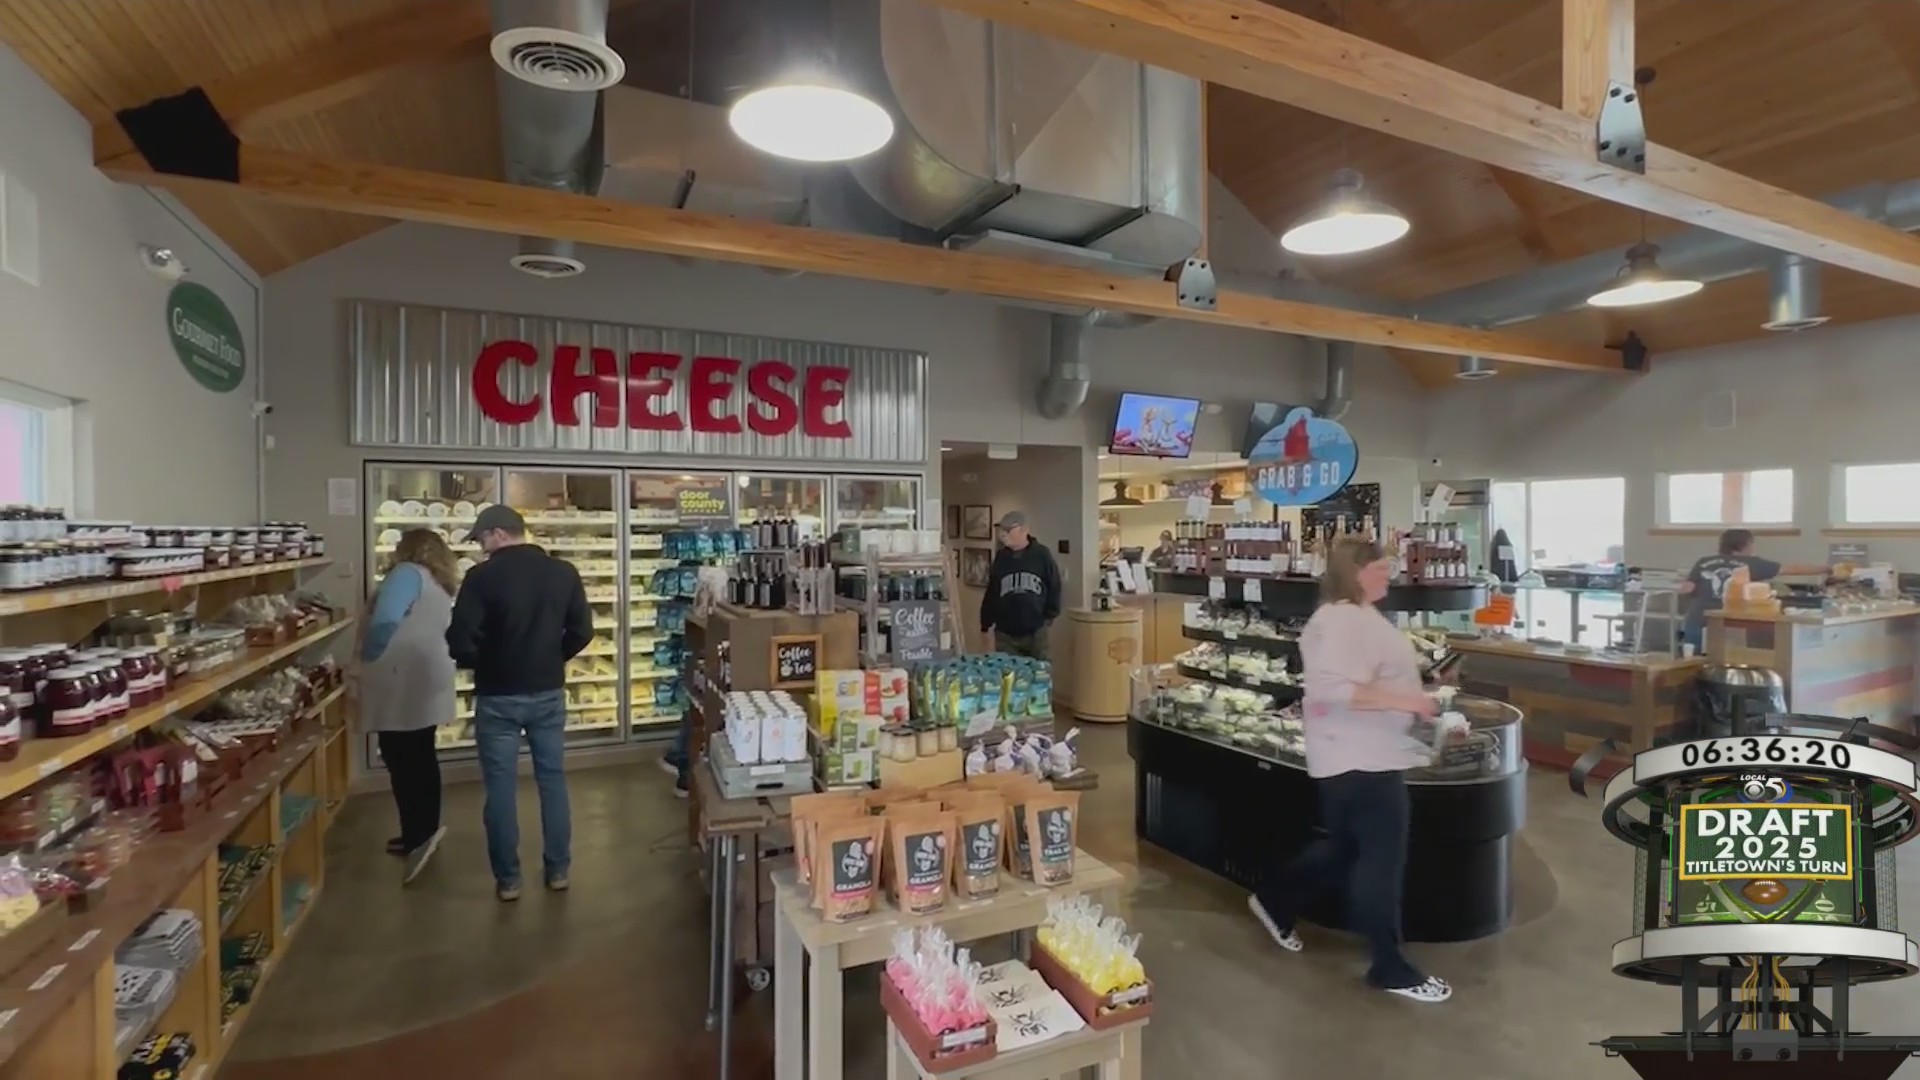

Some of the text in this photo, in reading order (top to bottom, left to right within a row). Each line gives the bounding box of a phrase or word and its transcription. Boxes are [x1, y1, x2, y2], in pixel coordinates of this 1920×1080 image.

[472, 339, 853, 438] CHEESE
[1258, 461, 1340, 490] GRAB & GO
[679, 489, 710, 499] door
[680, 499, 725, 511] county
[894, 606, 935, 626] Coffee
[779, 646, 812, 661] Coffee
[794, 662, 814, 675] Tea
